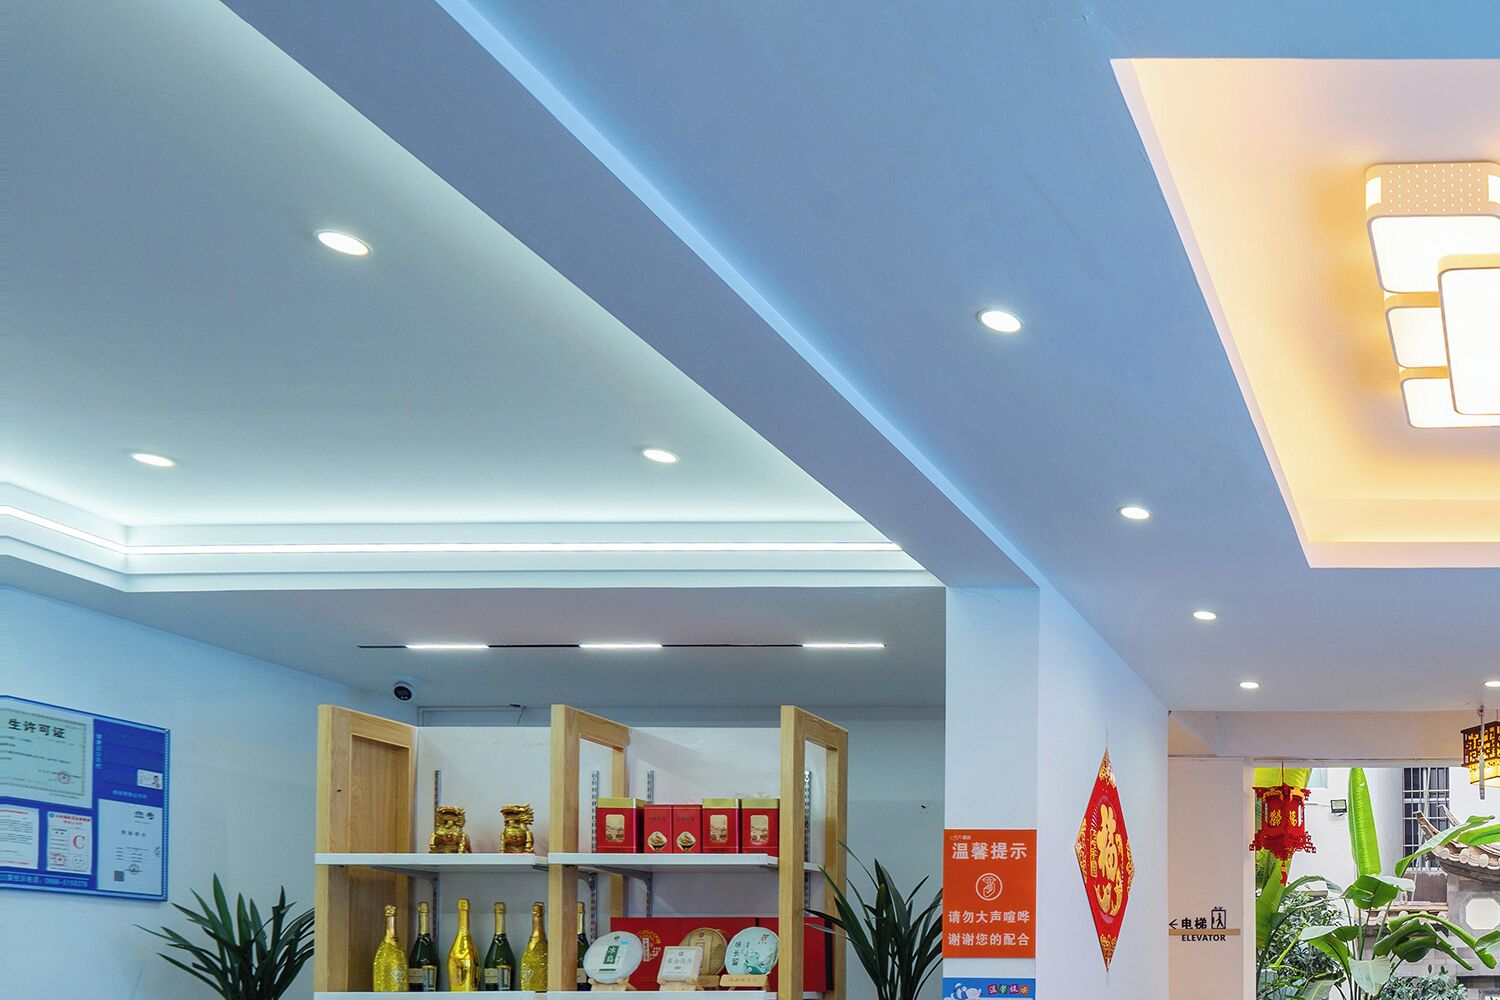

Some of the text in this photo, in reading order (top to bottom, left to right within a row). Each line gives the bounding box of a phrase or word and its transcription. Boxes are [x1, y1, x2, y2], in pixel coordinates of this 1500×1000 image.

[951, 842, 1028, 860] 温馨提示
[947, 910, 1030, 924] 请勿大声喧哗
[1181, 917, 1207, 929] 电梯
[947, 933, 1030, 946] 谢谢您的配合
[1181, 934, 1227, 942] ELEVATOR
